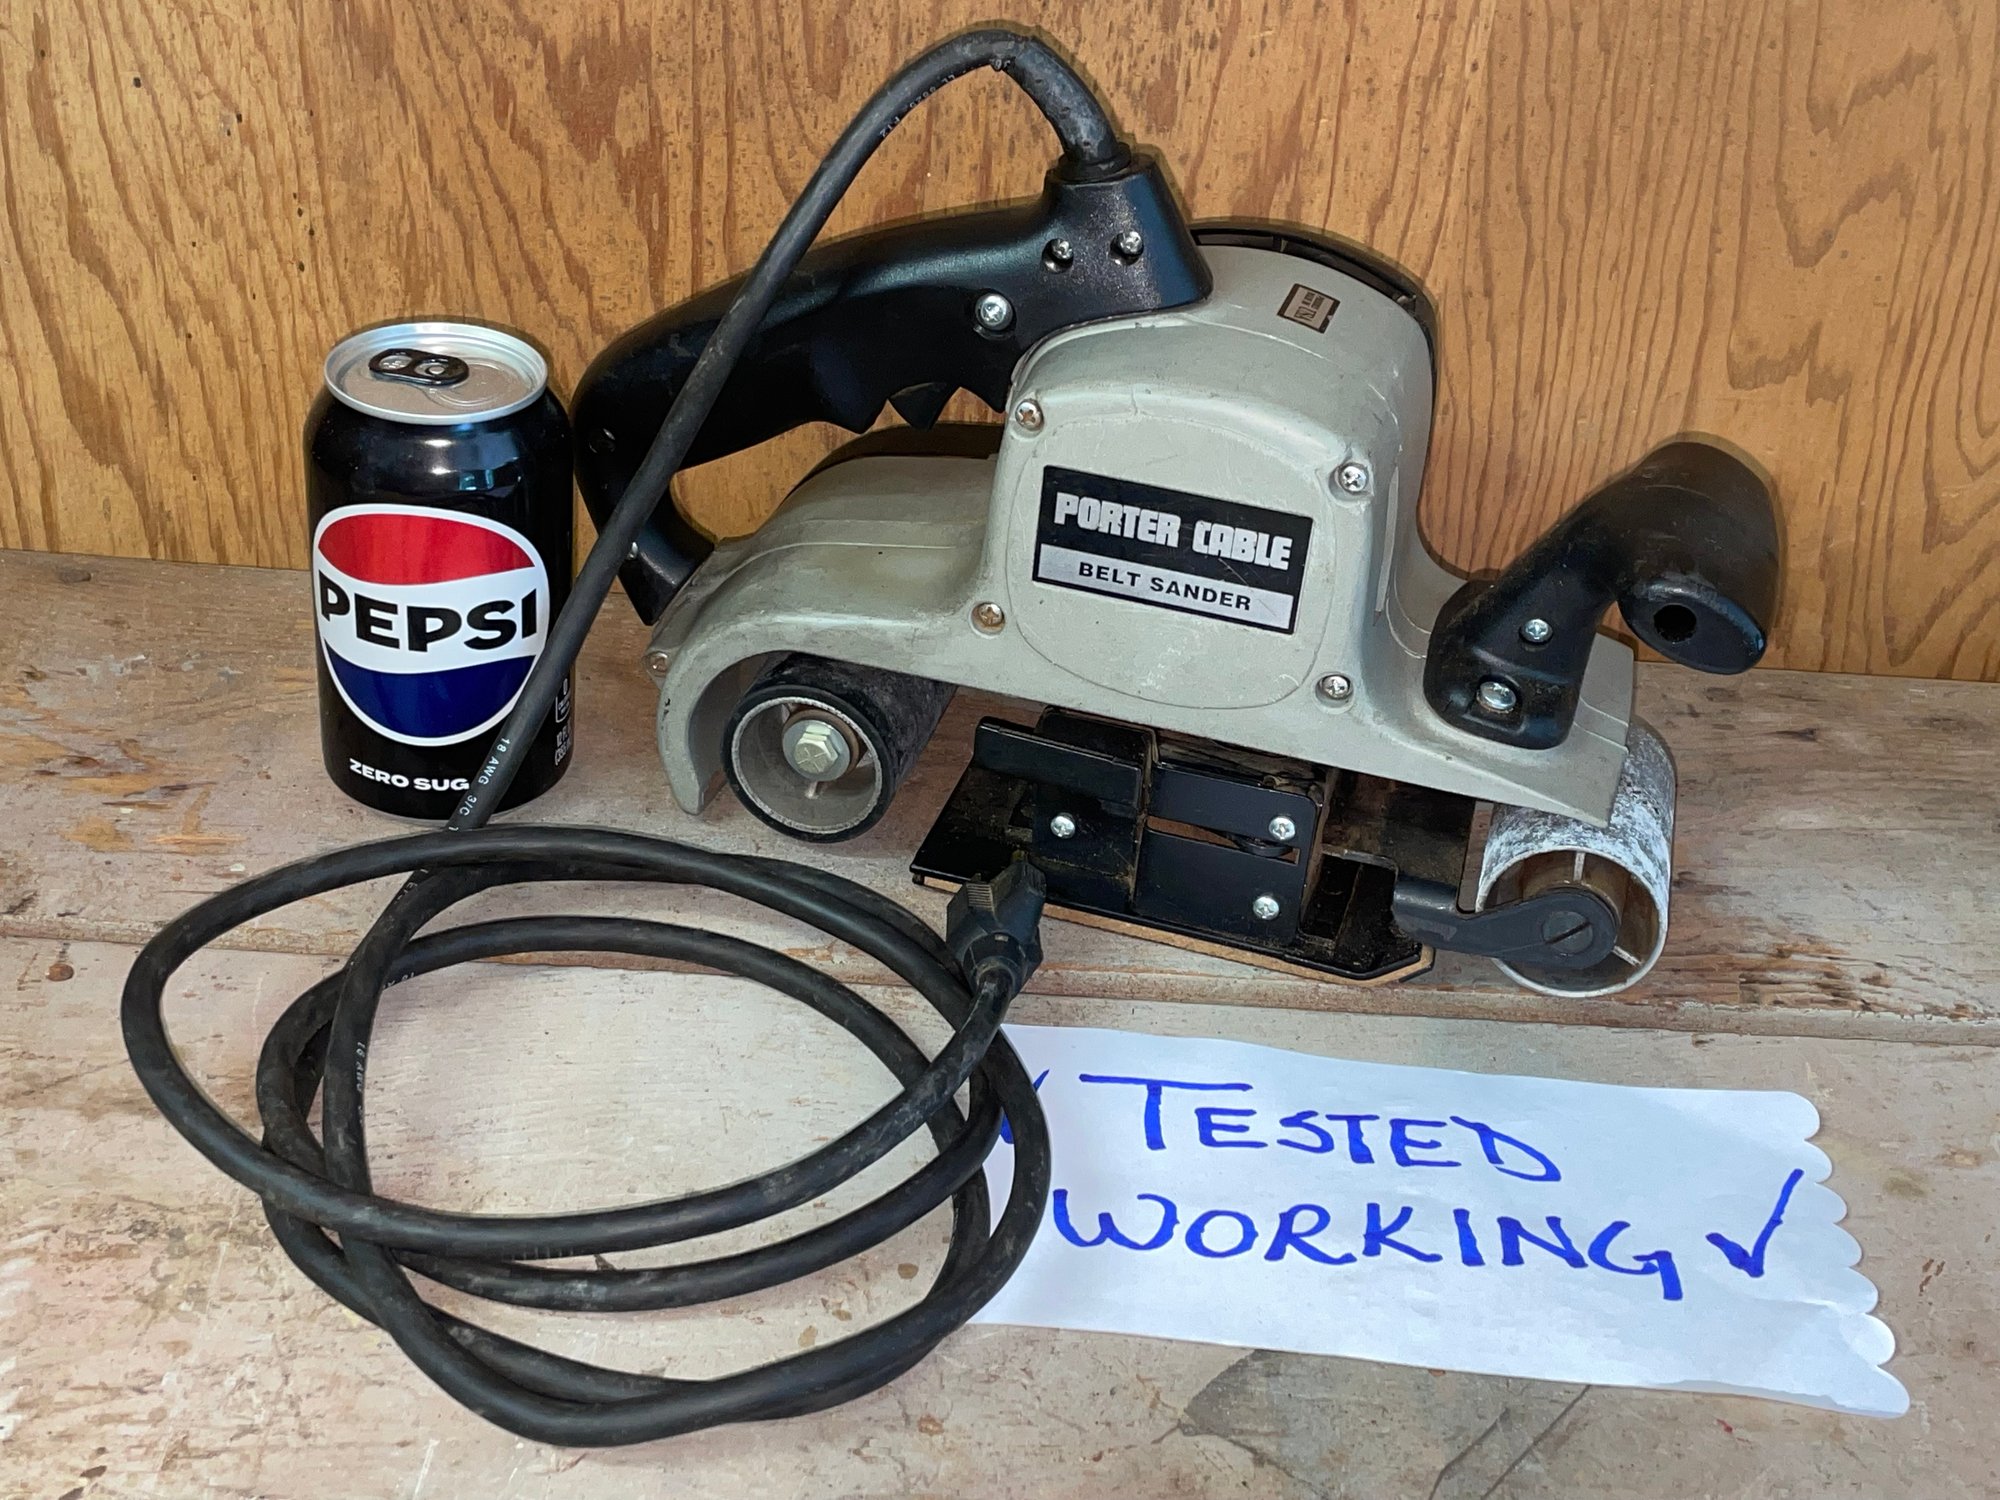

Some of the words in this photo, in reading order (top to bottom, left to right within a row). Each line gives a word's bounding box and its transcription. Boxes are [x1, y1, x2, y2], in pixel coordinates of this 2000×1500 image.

[1054, 492, 1181, 547] PORTER
[1192, 520, 1293, 570] CABLE
[319, 570, 537, 652] PEPSI
[1079, 562, 1141, 586] BELT
[1149, 577, 1251, 611] SANDER
[350, 758, 409, 788] ZERO
[413, 778, 470, 792] SUG
[478, 756, 499, 785] AWG
[497, 738, 510, 753] 18
[1079, 1074, 1561, 1182] TESTED
[1053, 1189, 1683, 1301] WORKING
